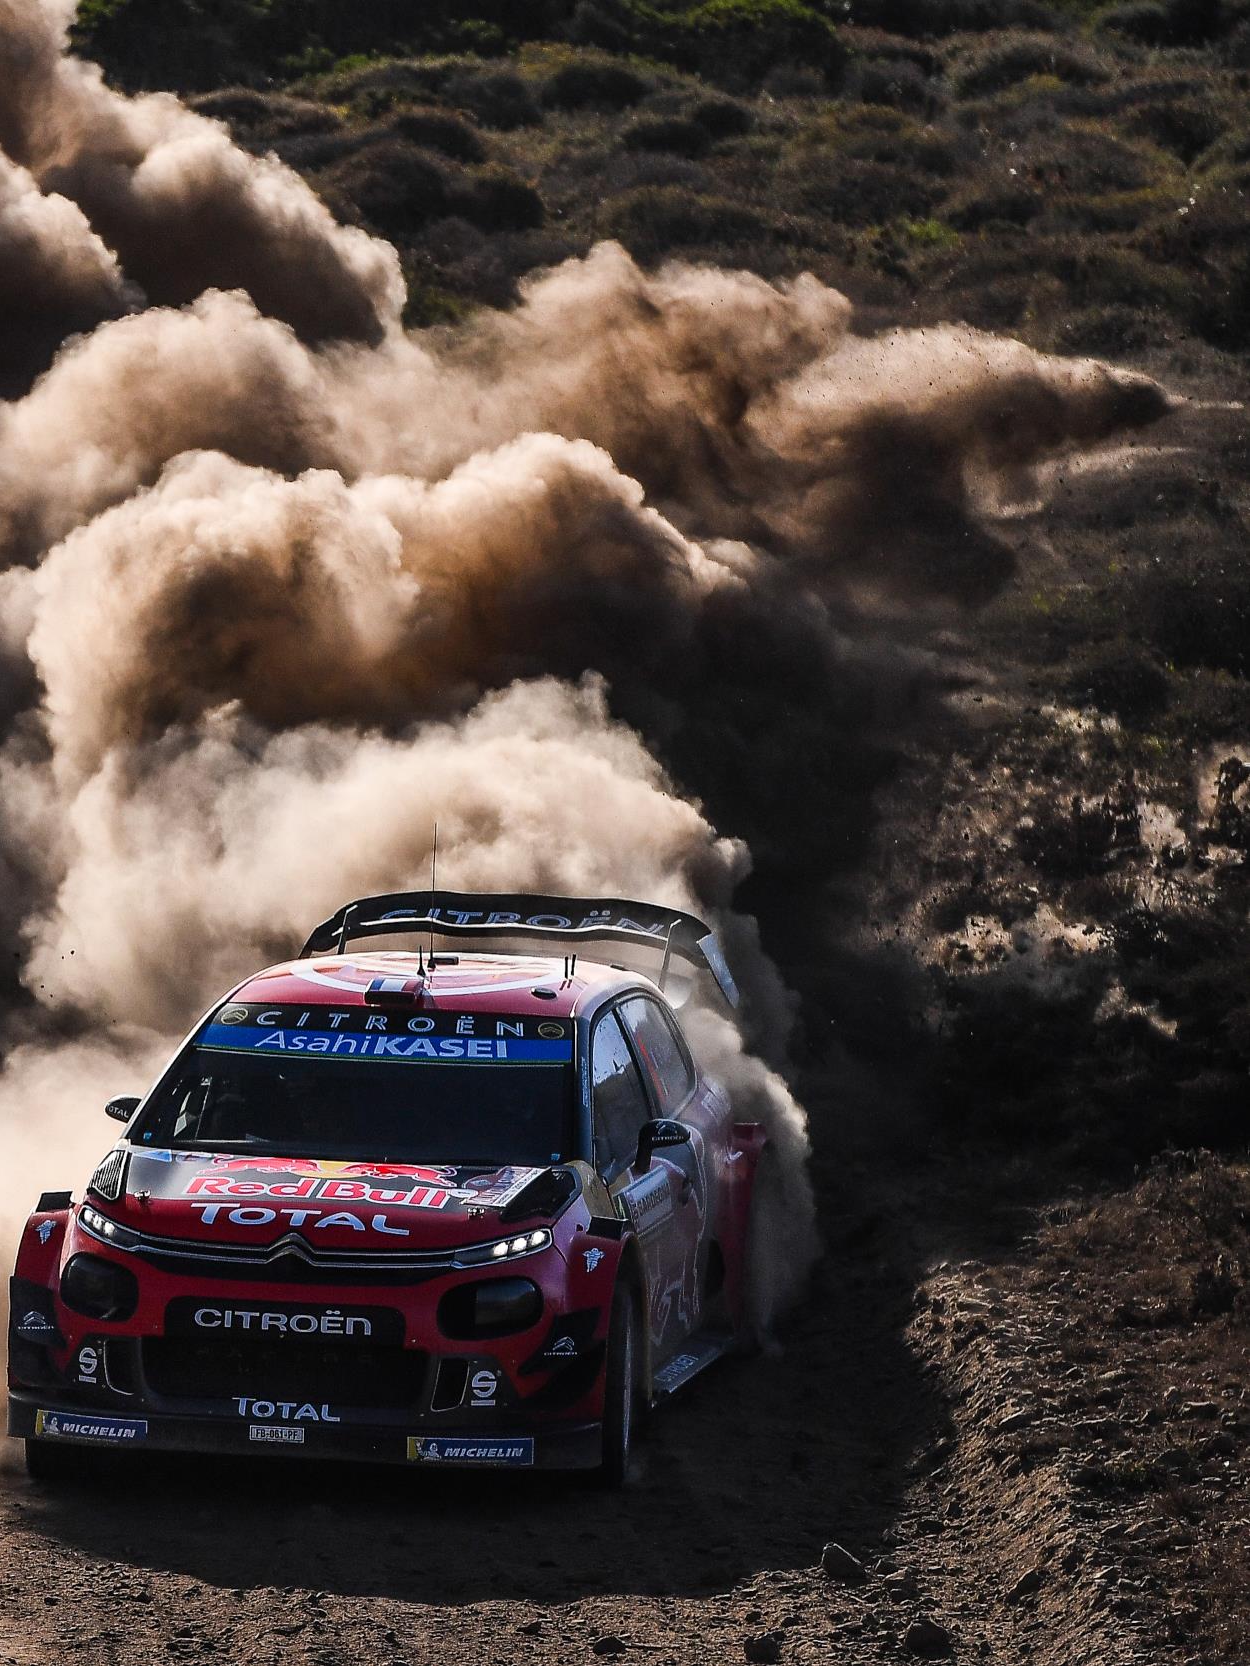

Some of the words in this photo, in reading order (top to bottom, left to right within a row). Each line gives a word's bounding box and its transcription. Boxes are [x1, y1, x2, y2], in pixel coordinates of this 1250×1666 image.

[256, 1010, 525, 1037] CITROËN
[255, 1031, 508, 1059] AsahiKASEI
[185, 1177, 317, 1200] Red
[318, 1180, 452, 1208] Bull
[190, 1203, 410, 1236] TOTAL
[194, 1308, 372, 1336] CITROËN
[232, 1397, 341, 1422] TOTAL
[62, 1422, 136, 1438] MICHELIN
[443, 1447, 524, 1458] MICHELIN
